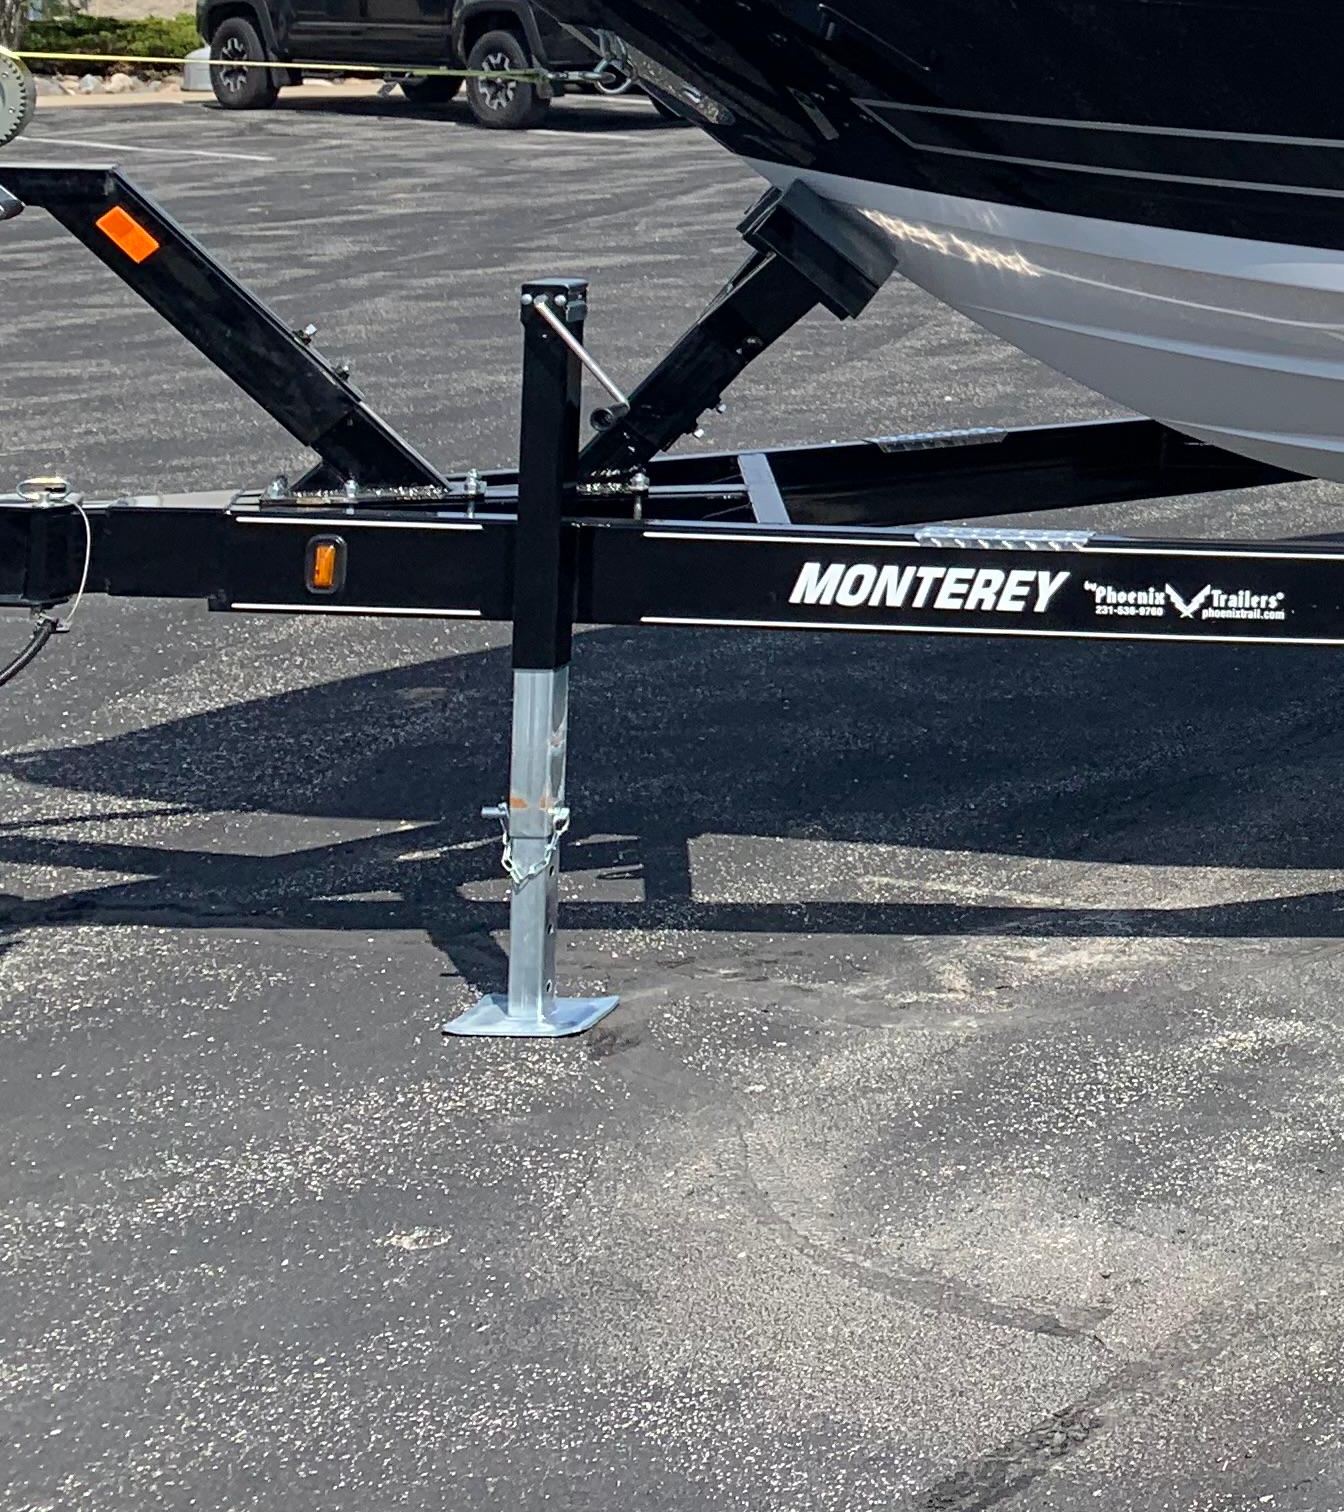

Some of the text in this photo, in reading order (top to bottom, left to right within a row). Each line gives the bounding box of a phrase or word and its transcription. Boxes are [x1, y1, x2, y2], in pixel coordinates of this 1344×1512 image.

[788, 562, 1071, 613] MONTEREY
[1095, 585, 1166, 605] Phoenix
[1201, 607, 1285, 620] phoenixtrail.com
